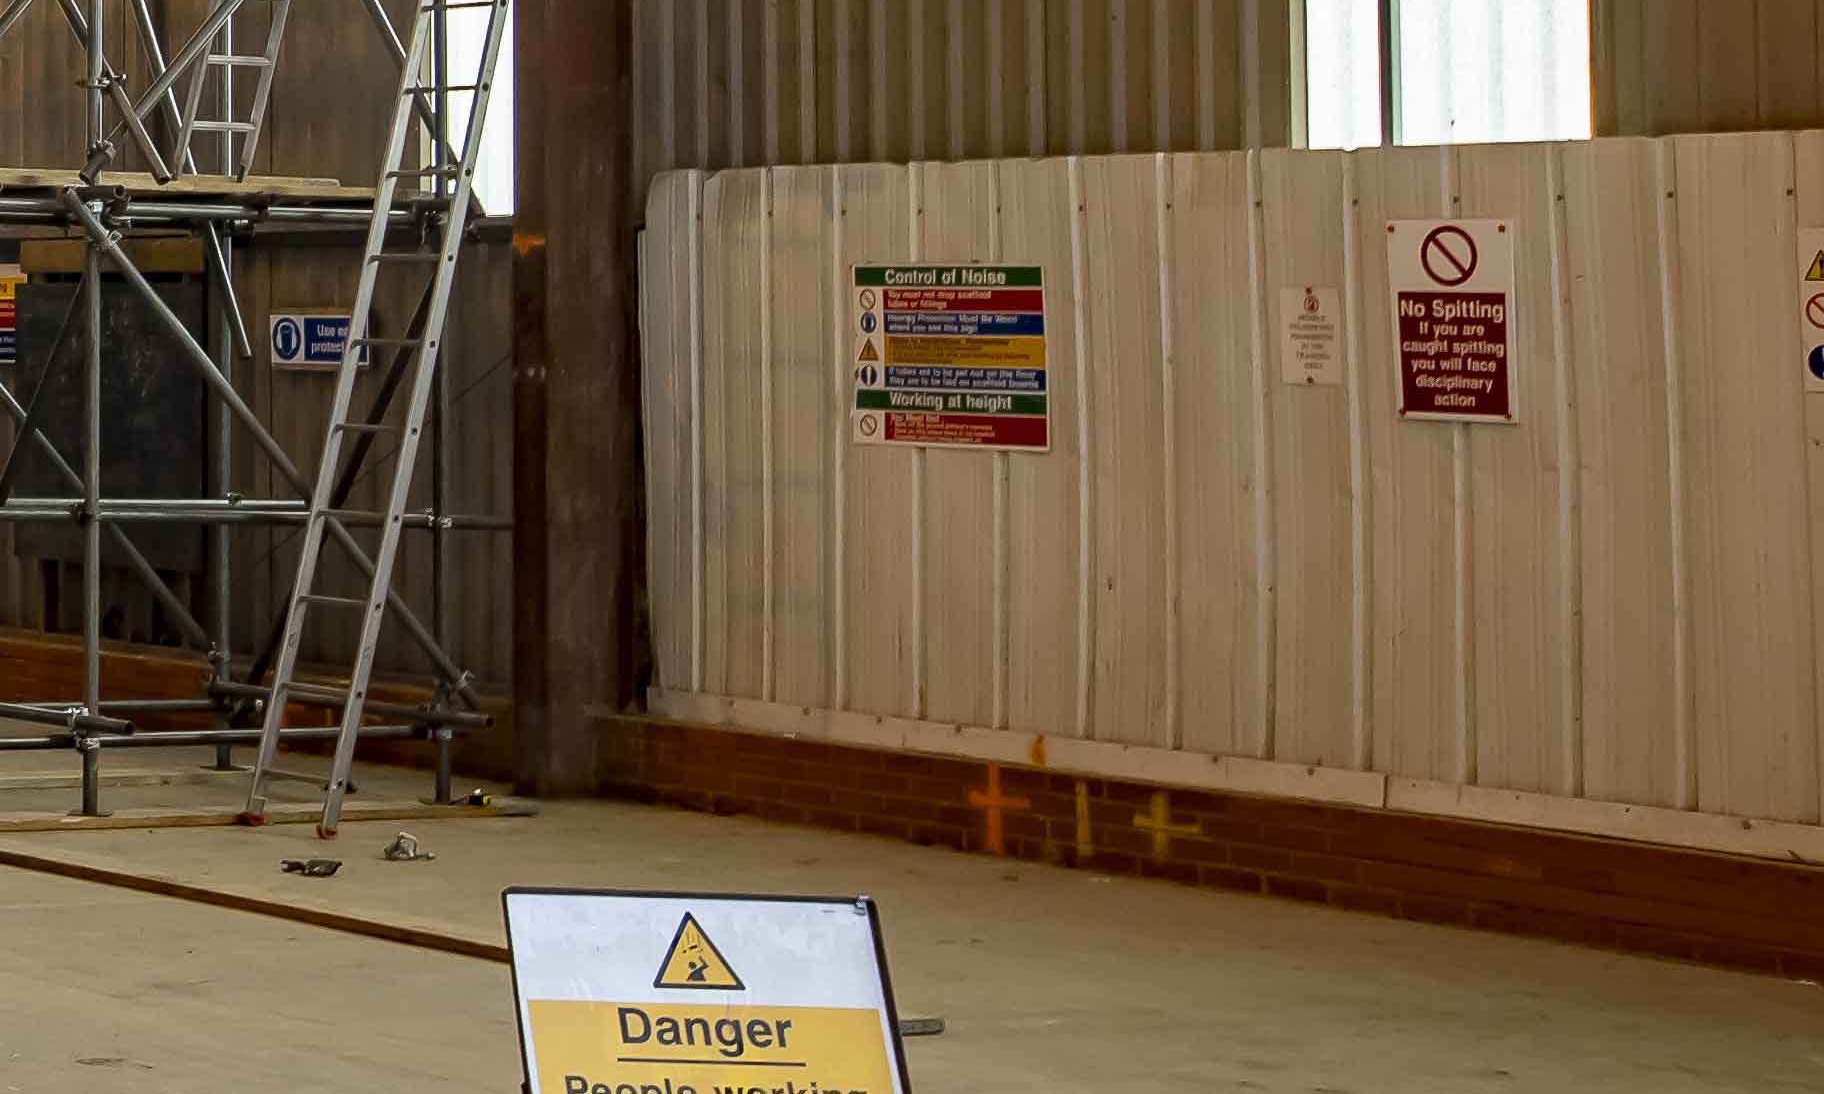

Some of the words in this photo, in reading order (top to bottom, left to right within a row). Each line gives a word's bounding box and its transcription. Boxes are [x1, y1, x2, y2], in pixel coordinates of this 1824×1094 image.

[884, 269, 937, 284] Control
[941, 269, 956, 284] of
[961, 269, 1006, 285] Noise
[1400, 299, 1426, 317] No
[1432, 299, 1504, 323] Spitting
[317, 324, 336, 336] Use
[1419, 321, 1429, 335] If
[1433, 324, 1458, 338] you
[1462, 324, 1485, 336] are
[1403, 340, 1448, 356] caught
[1452, 340, 1505, 358] spitting
[1411, 359, 1435, 373] you
[1439, 357, 1462, 371] will
[1467, 357, 1497, 372] face
[1415, 374, 1493, 394] disciplinary
[889, 392, 943, 411] Working
[948, 394, 961, 408] at
[966, 394, 1012, 412] height
[1434, 393, 1476, 406] action
[617, 1007, 793, 1057] Danger
